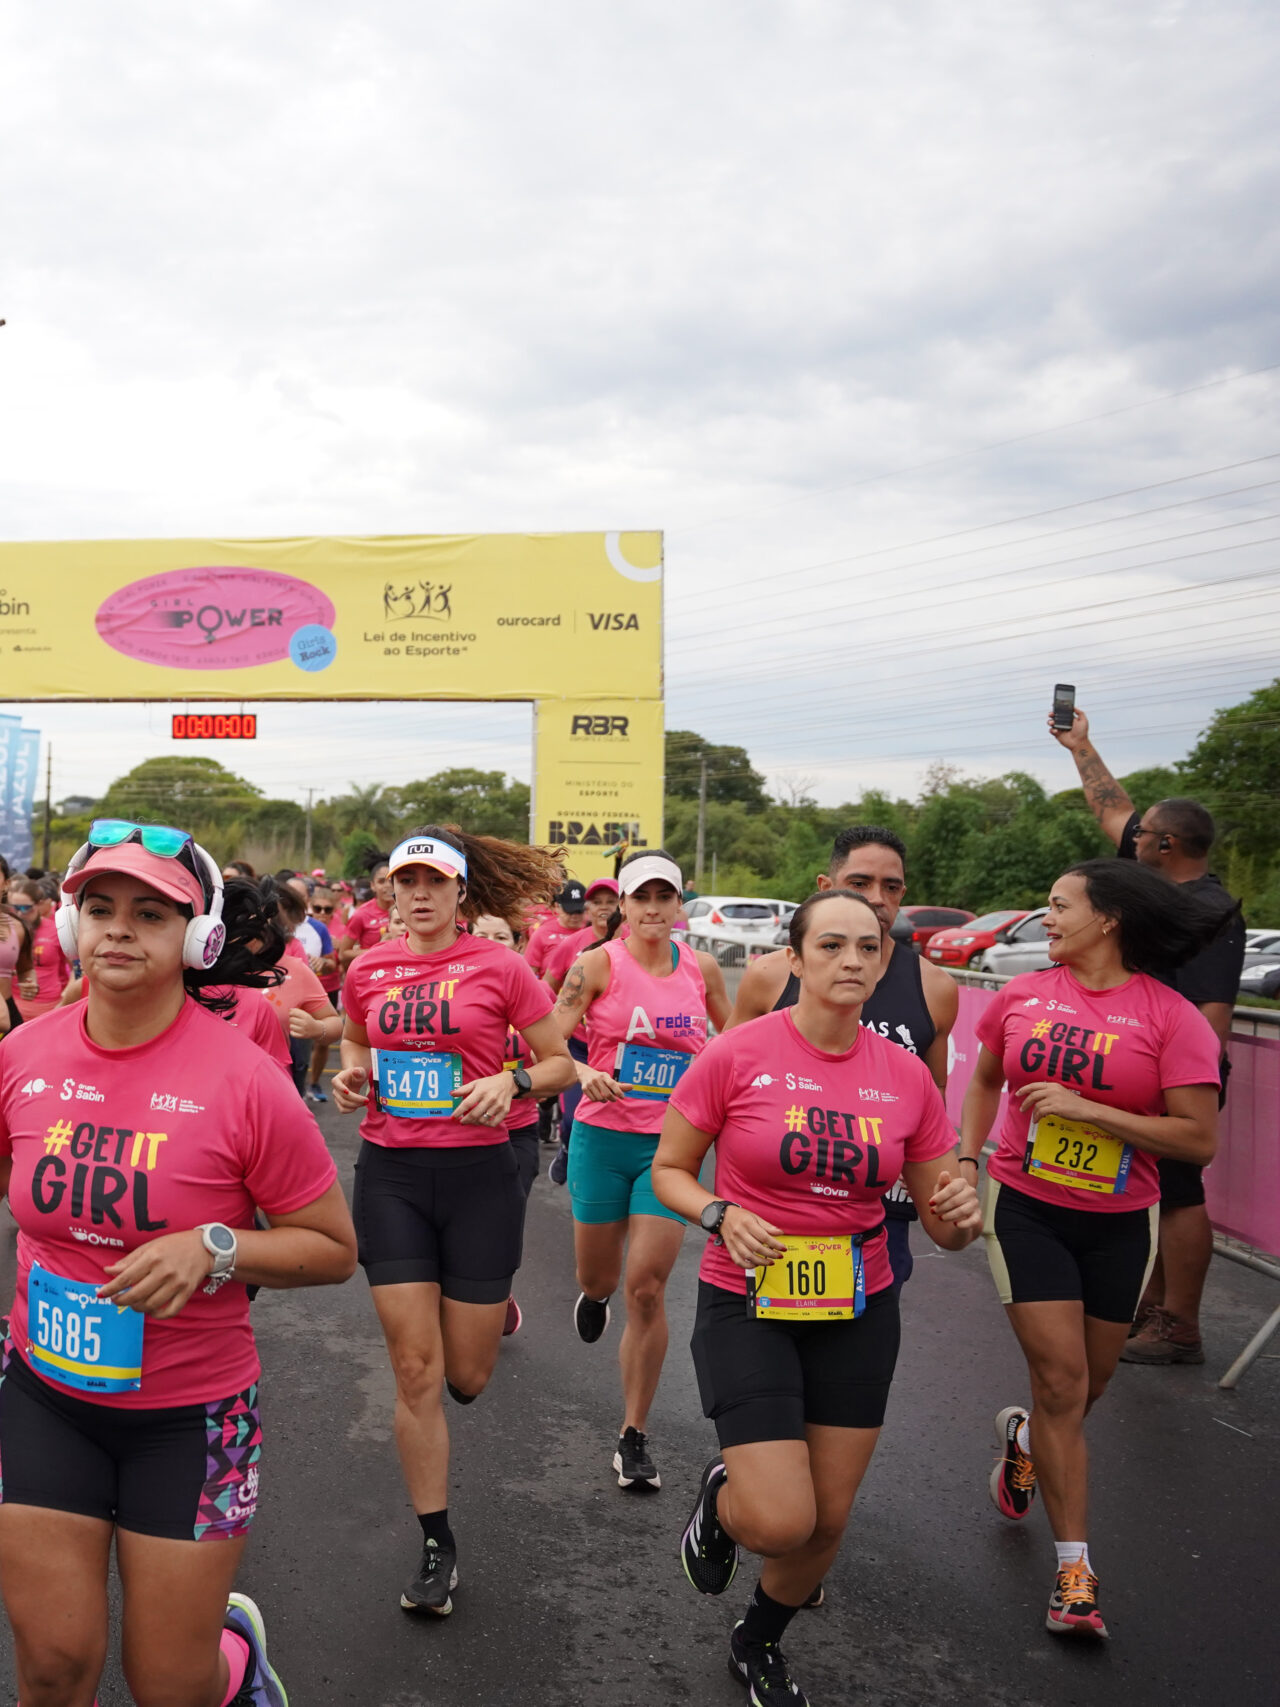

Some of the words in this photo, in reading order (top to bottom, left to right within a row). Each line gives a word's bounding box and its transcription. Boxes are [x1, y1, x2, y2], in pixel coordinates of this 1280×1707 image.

[150, 597, 195, 609] GIRL
[161, 606, 284, 629] POWER
[496, 615, 561, 628] ourocard
[588, 612, 640, 630] VISA
[363, 631, 385, 642] Lei
[389, 631, 407, 643] de
[411, 631, 477, 643] Incentivo
[299, 645, 331, 664] Rock
[383, 646, 401, 656] ao
[172, 714, 256, 739] 00:00:00
[570, 714, 630, 737] RBR
[557, 810, 598, 818] GOVERNO
[602, 811, 641, 819] FEDERAL
[548, 820, 648, 847] BRASIL
[409, 844, 432, 855] run
[378, 1000, 462, 1036] GIRL
[625, 1005, 657, 1041] A
[656, 1012, 691, 1029] rede
[858, 1019, 889, 1038] AS
[632, 1060, 676, 1087] 5401
[1020, 1037, 1114, 1091] GIRL
[75, 1089, 105, 1103] Sabin
[387, 1069, 439, 1099] 5479
[798, 1081, 823, 1092] Sabin
[779, 1131, 889, 1189] GIRL
[1054, 1136, 1098, 1172] 232
[1120, 1152, 1131, 1175] AZUL
[31, 1154, 169, 1232] GIRL
[786, 1260, 826, 1296] 160
[38, 1299, 102, 1362] 5685
